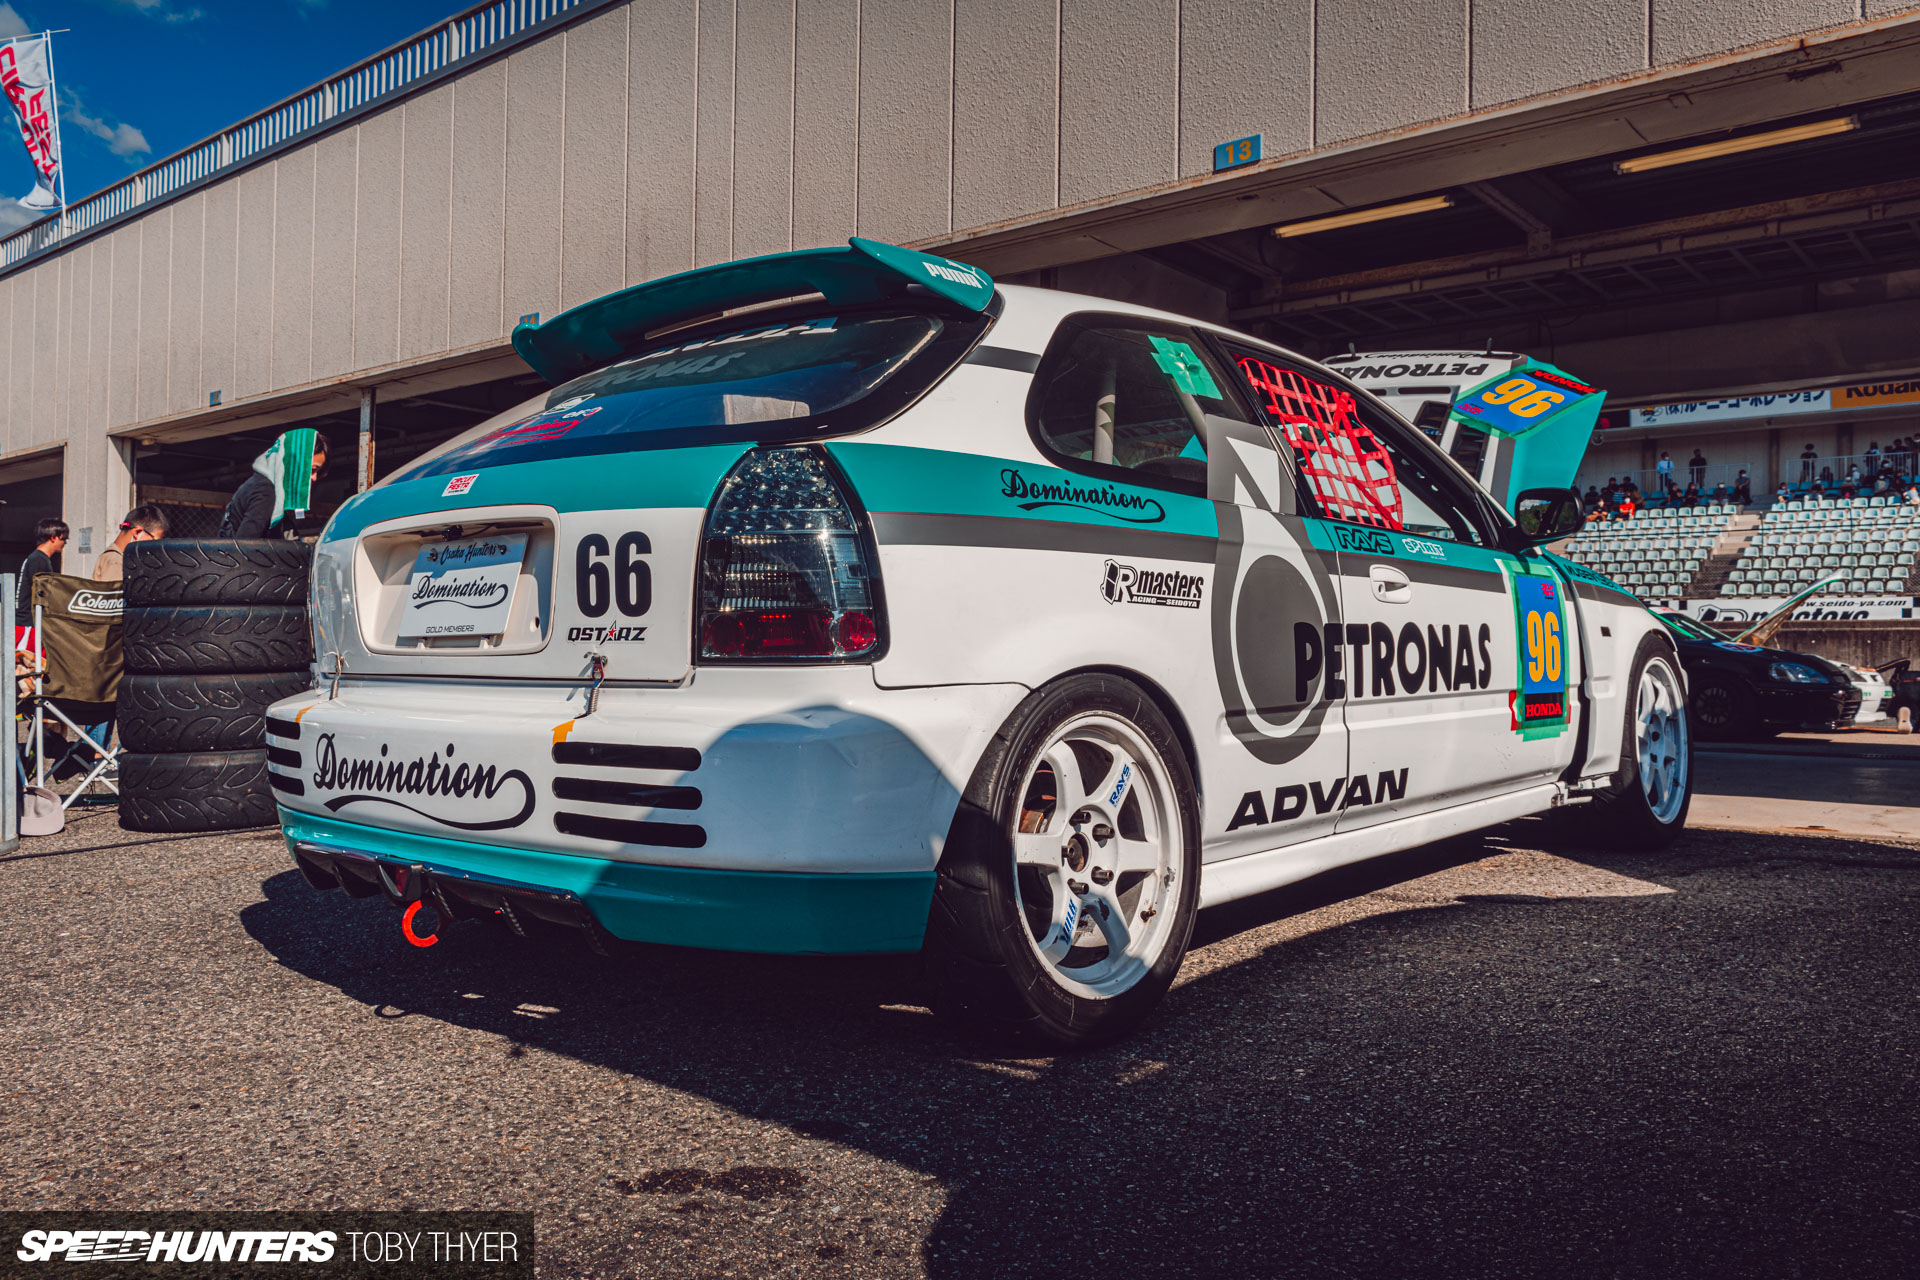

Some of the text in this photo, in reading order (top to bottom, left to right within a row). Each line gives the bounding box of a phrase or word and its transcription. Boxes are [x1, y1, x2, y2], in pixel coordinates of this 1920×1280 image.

[1225, 140, 1252, 164] 13
[922, 261, 983, 289] PUMA
[1534, 370, 1596, 393] HONDA
[1481, 378, 1565, 418] 96
[1001, 468, 1166, 523] Domination
[464, 542, 497, 563] Hunters
[1333, 526, 1395, 555] RAYS
[1402, 538, 1445, 556] SPIRIT
[575, 530, 652, 618] 66
[78, 593, 126, 609] Colema
[412, 575, 508, 609] Domination
[425, 624, 475, 634] GOLD MEMBERS
[568, 620, 648, 645] QSTARZ
[1527, 610, 1562, 682] 96
[1293, 621, 1492, 702] PETRONAS
[1525, 702, 1563, 718] HONDA
[313, 732, 536, 831] Domination
[1108, 763, 1131, 805] RAYS
[1225, 767, 1410, 832] ADVAN
